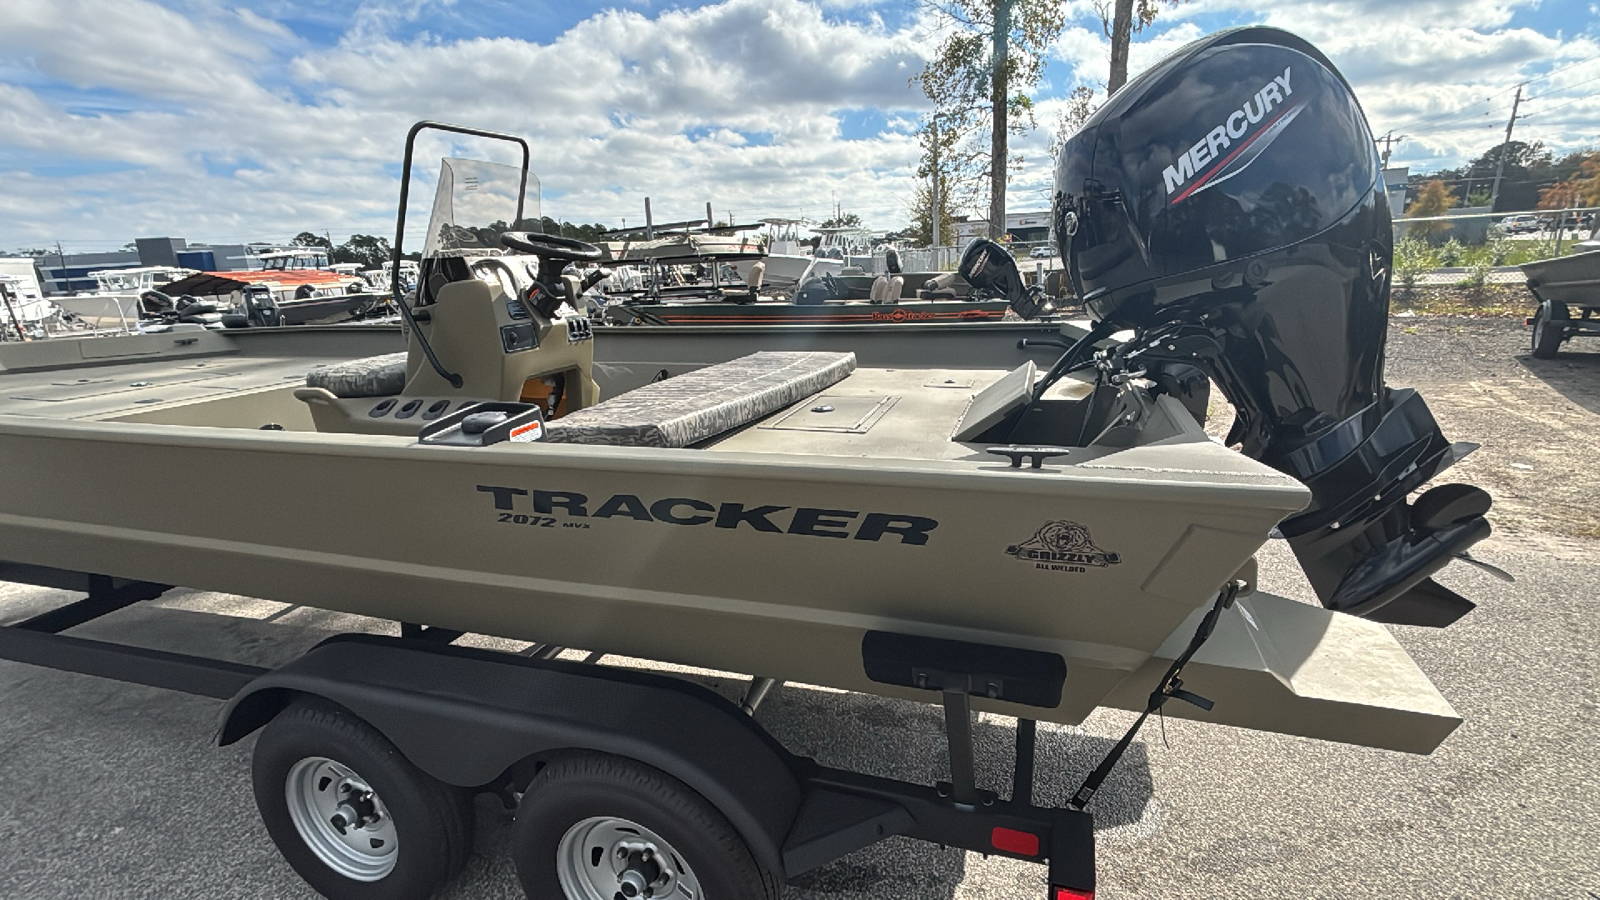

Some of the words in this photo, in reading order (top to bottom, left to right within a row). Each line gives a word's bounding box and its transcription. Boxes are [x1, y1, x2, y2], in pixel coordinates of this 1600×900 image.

[1162, 66, 1292, 195] MERCURY
[476, 484, 939, 546] TRACKER
[497, 512, 557, 528] 2072
[562, 522, 591, 530] MVX
[1026, 549, 1096, 563] GRIZZLY
[1035, 562, 1049, 571] ALL
[1051, 564, 1086, 573] WELDED
